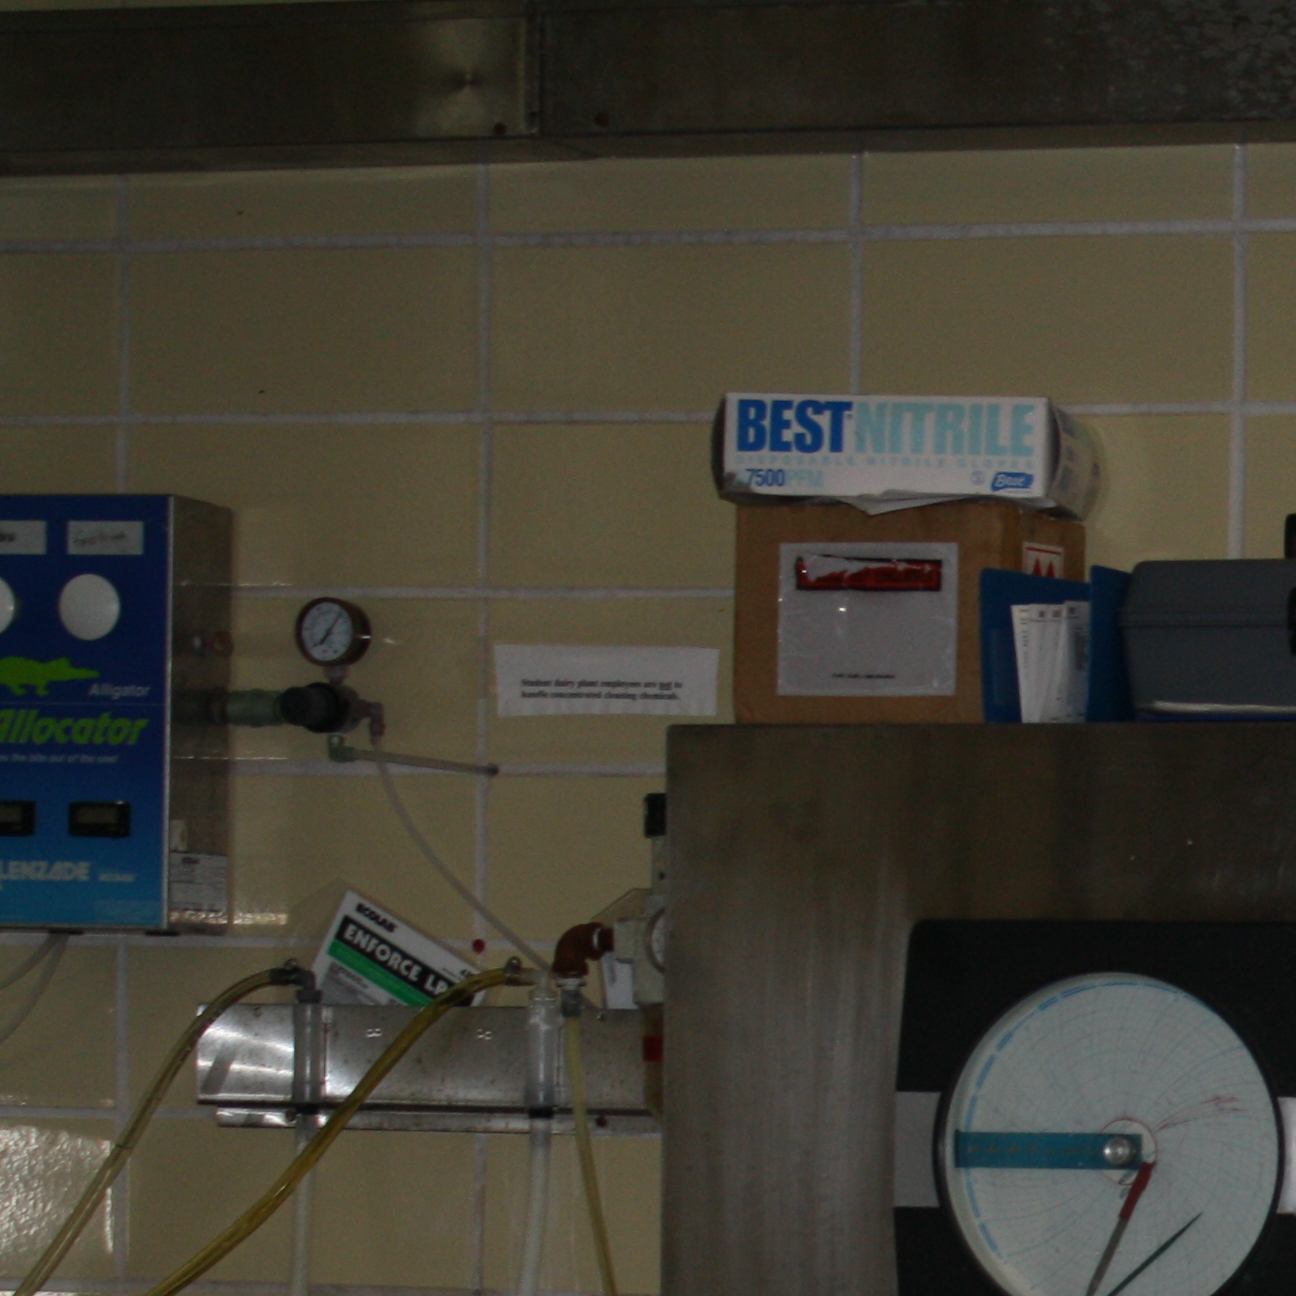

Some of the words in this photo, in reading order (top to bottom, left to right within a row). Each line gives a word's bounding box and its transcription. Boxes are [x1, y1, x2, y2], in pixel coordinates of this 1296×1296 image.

[737, 399, 853, 453] BEST
[857, 402, 1036, 457] NITRILE
[746, 469, 786, 487] 7500
[88, 683, 152, 700] Alligator
[343, 923, 423, 982] ENFORCE
